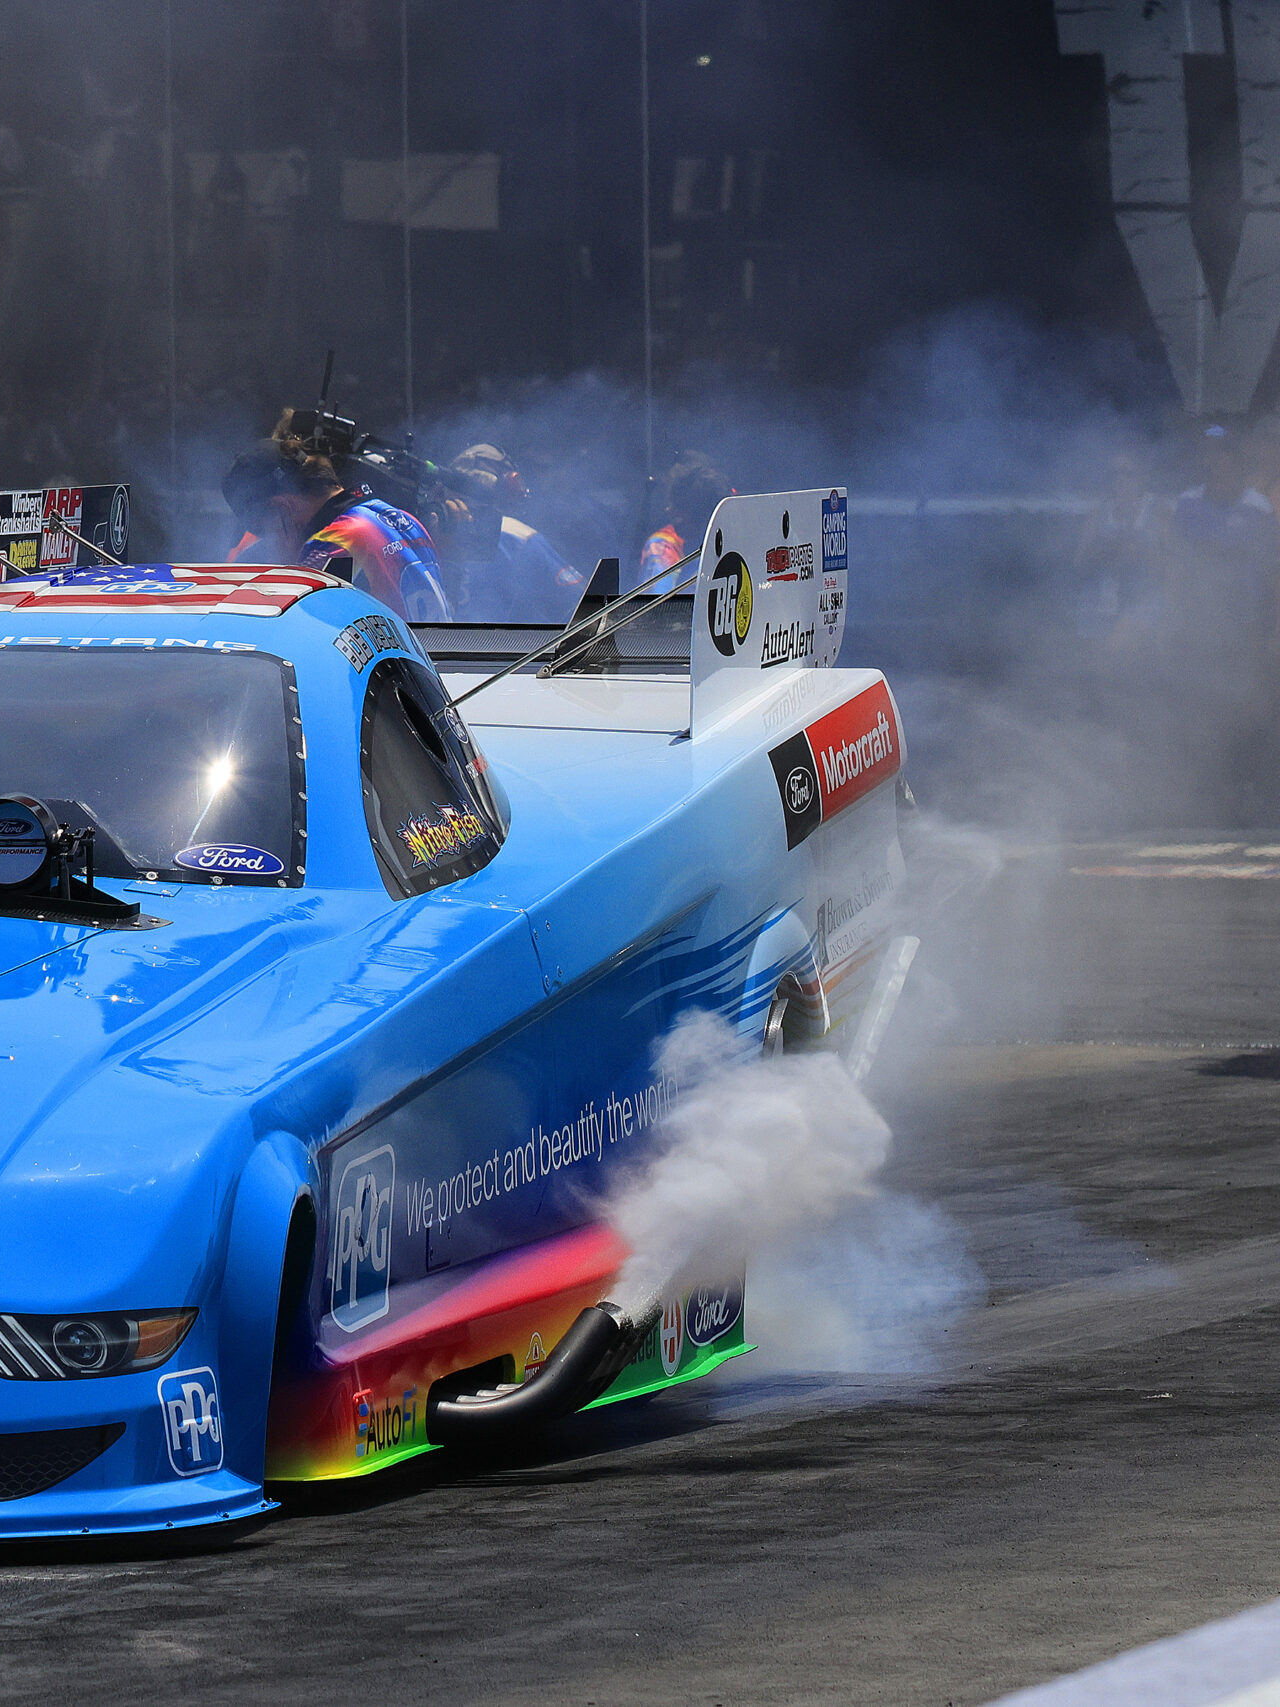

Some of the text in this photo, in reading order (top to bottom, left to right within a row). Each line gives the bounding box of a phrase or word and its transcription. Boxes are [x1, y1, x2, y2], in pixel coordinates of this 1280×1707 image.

[12, 492, 42, 517] Winberg
[42, 489, 83, 519] ARP
[822, 512, 846, 534] CAMPING
[382, 540, 403, 558] FORD
[823, 532, 847, 557] WORLD
[333, 624, 375, 675] BOB
[761, 620, 815, 663] AutoAlert
[820, 711, 893, 794] Motorcraft
[789, 773, 810, 808] Ford
[198, 847, 265, 871] Ford
[406, 1065, 679, 1237] We protect and beautify the world
[335, 1171, 391, 1309] PPG
[695, 1284, 730, 1337] Ford
[167, 1381, 220, 1462] PPG
